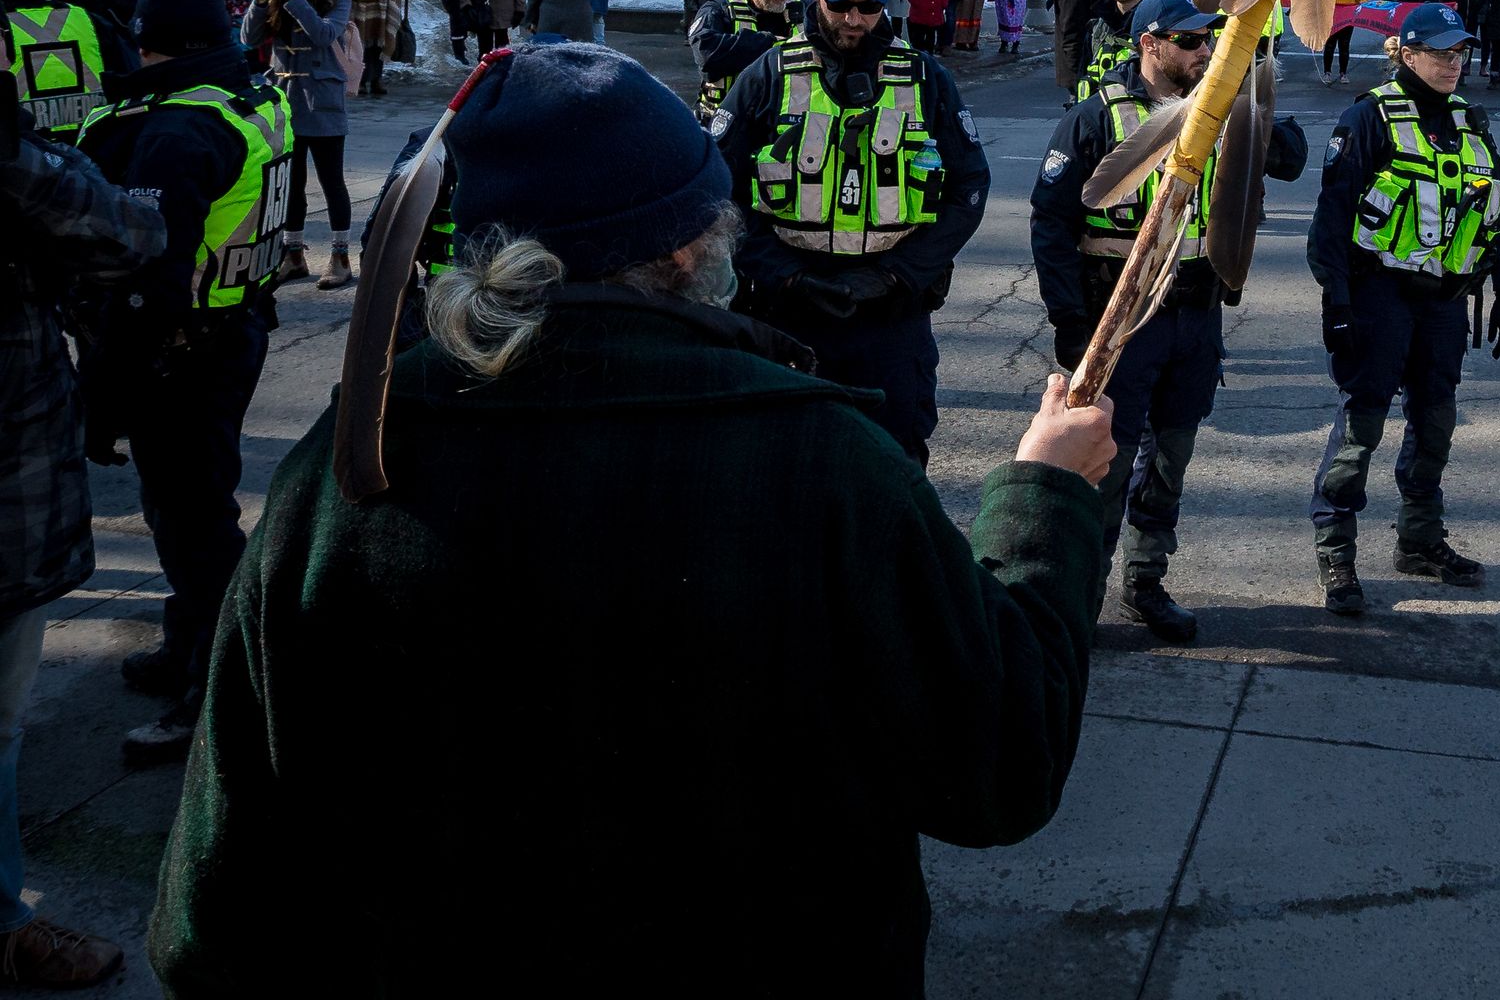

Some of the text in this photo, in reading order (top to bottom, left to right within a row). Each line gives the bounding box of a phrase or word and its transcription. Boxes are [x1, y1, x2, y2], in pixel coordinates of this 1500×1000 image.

[716, 108, 734, 120] POLICE
[1050, 149, 1070, 163] POLICE
[843, 168, 860, 187] A
[1467, 165, 1493, 175] POLICE
[128, 187, 164, 198] POLICE
[261, 158, 292, 236] A31
[841, 186, 861, 205] 31
[1445, 207, 1456, 222] A
[223, 230, 284, 286] POLIC
